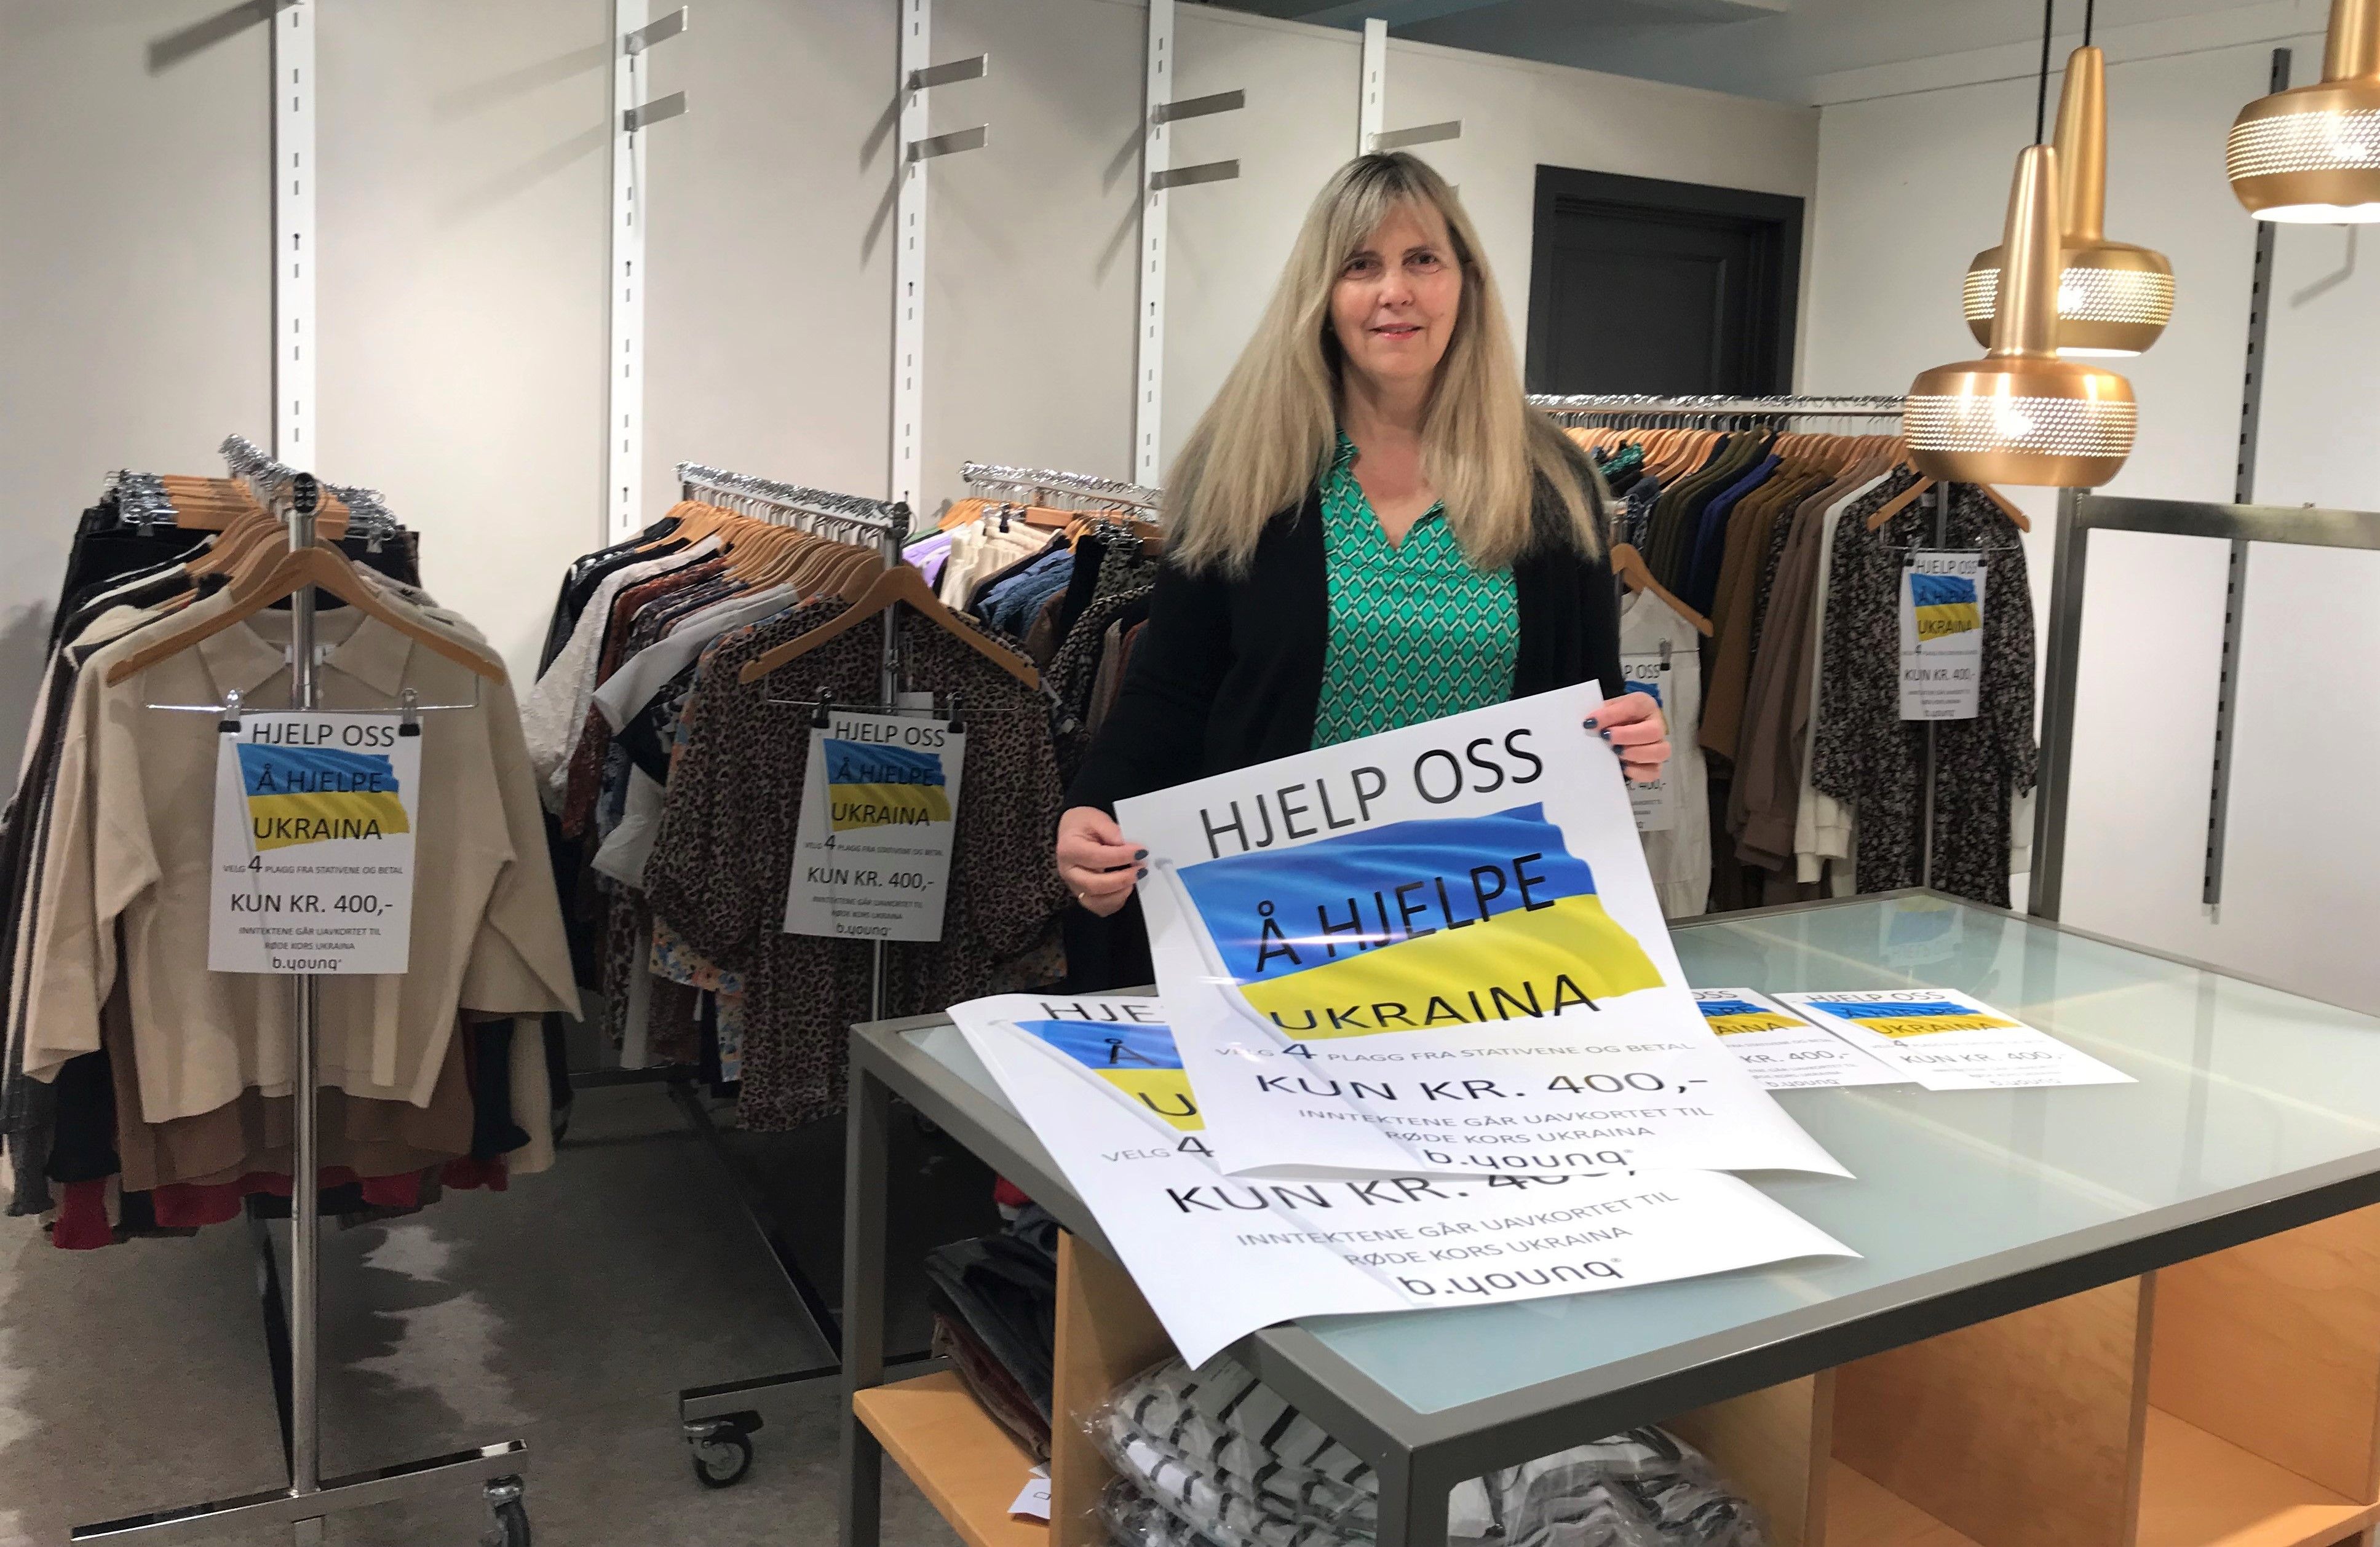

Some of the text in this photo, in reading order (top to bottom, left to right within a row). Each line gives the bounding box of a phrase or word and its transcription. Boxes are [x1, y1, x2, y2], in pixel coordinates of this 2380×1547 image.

[252, 722, 395, 747] HJELP OSS
[835, 721, 945, 748] HJELP OSS
[257, 763, 383, 793] Å HJELPE
[836, 756, 935, 787] Å HJELPE
[1200, 727, 1544, 858] HJELP OSS
[831, 802, 930, 826] UKRAINA
[253, 817, 383, 841] UKRAINA
[824, 835, 836, 850] 4
[248, 855, 263, 873] 4
[807, 866, 935, 892] KUN KR. 400,-
[231, 893, 394, 917] KUN KR. 400,-
[1255, 852, 1557, 973] Å HJELPE
[1269, 973, 1601, 1031] UKRAINA
[1806, 991, 1946, 1003] HJELP OSS
[1040, 1002, 1167, 1023] HJE
[1716, 1022, 1790, 1035] AINA
[1868, 1022, 2002, 1035] UKRAINA
[1104, 1037, 1159, 1067] Å
[1282, 1043, 1319, 1060] 4
[1327, 1053, 1405, 1062] PLAGG
[1411, 1050, 1457, 1062] FRA
[1459, 1046, 1579, 1058] STATIVENE
[1584, 1045, 1627, 1054] OG
[1628, 1043, 1696, 1053] BETAL
[1739, 1050, 1850, 1063] KR. 400,-
[1899, 1054, 1958, 1064] KUN
[1255, 1072, 1709, 1101] KUN KR. 400,-
[1299, 1107, 1715, 1128] INNTEKTENE GÅR UAVKORTET TIL
[1384, 1126, 1657, 1144] RØDE KORS UKRAINA
[1102, 1135, 1215, 1162] VELG 4
[1165, 1184, 1334, 1214] KUN
[1346, 1176, 1470, 1206] KR.
[1236, 1191, 1680, 1246] INNTEKTENE GÅR UAVKORTET TIL
[1343, 1226, 1634, 1267] RØDE KORS UKRAINA
